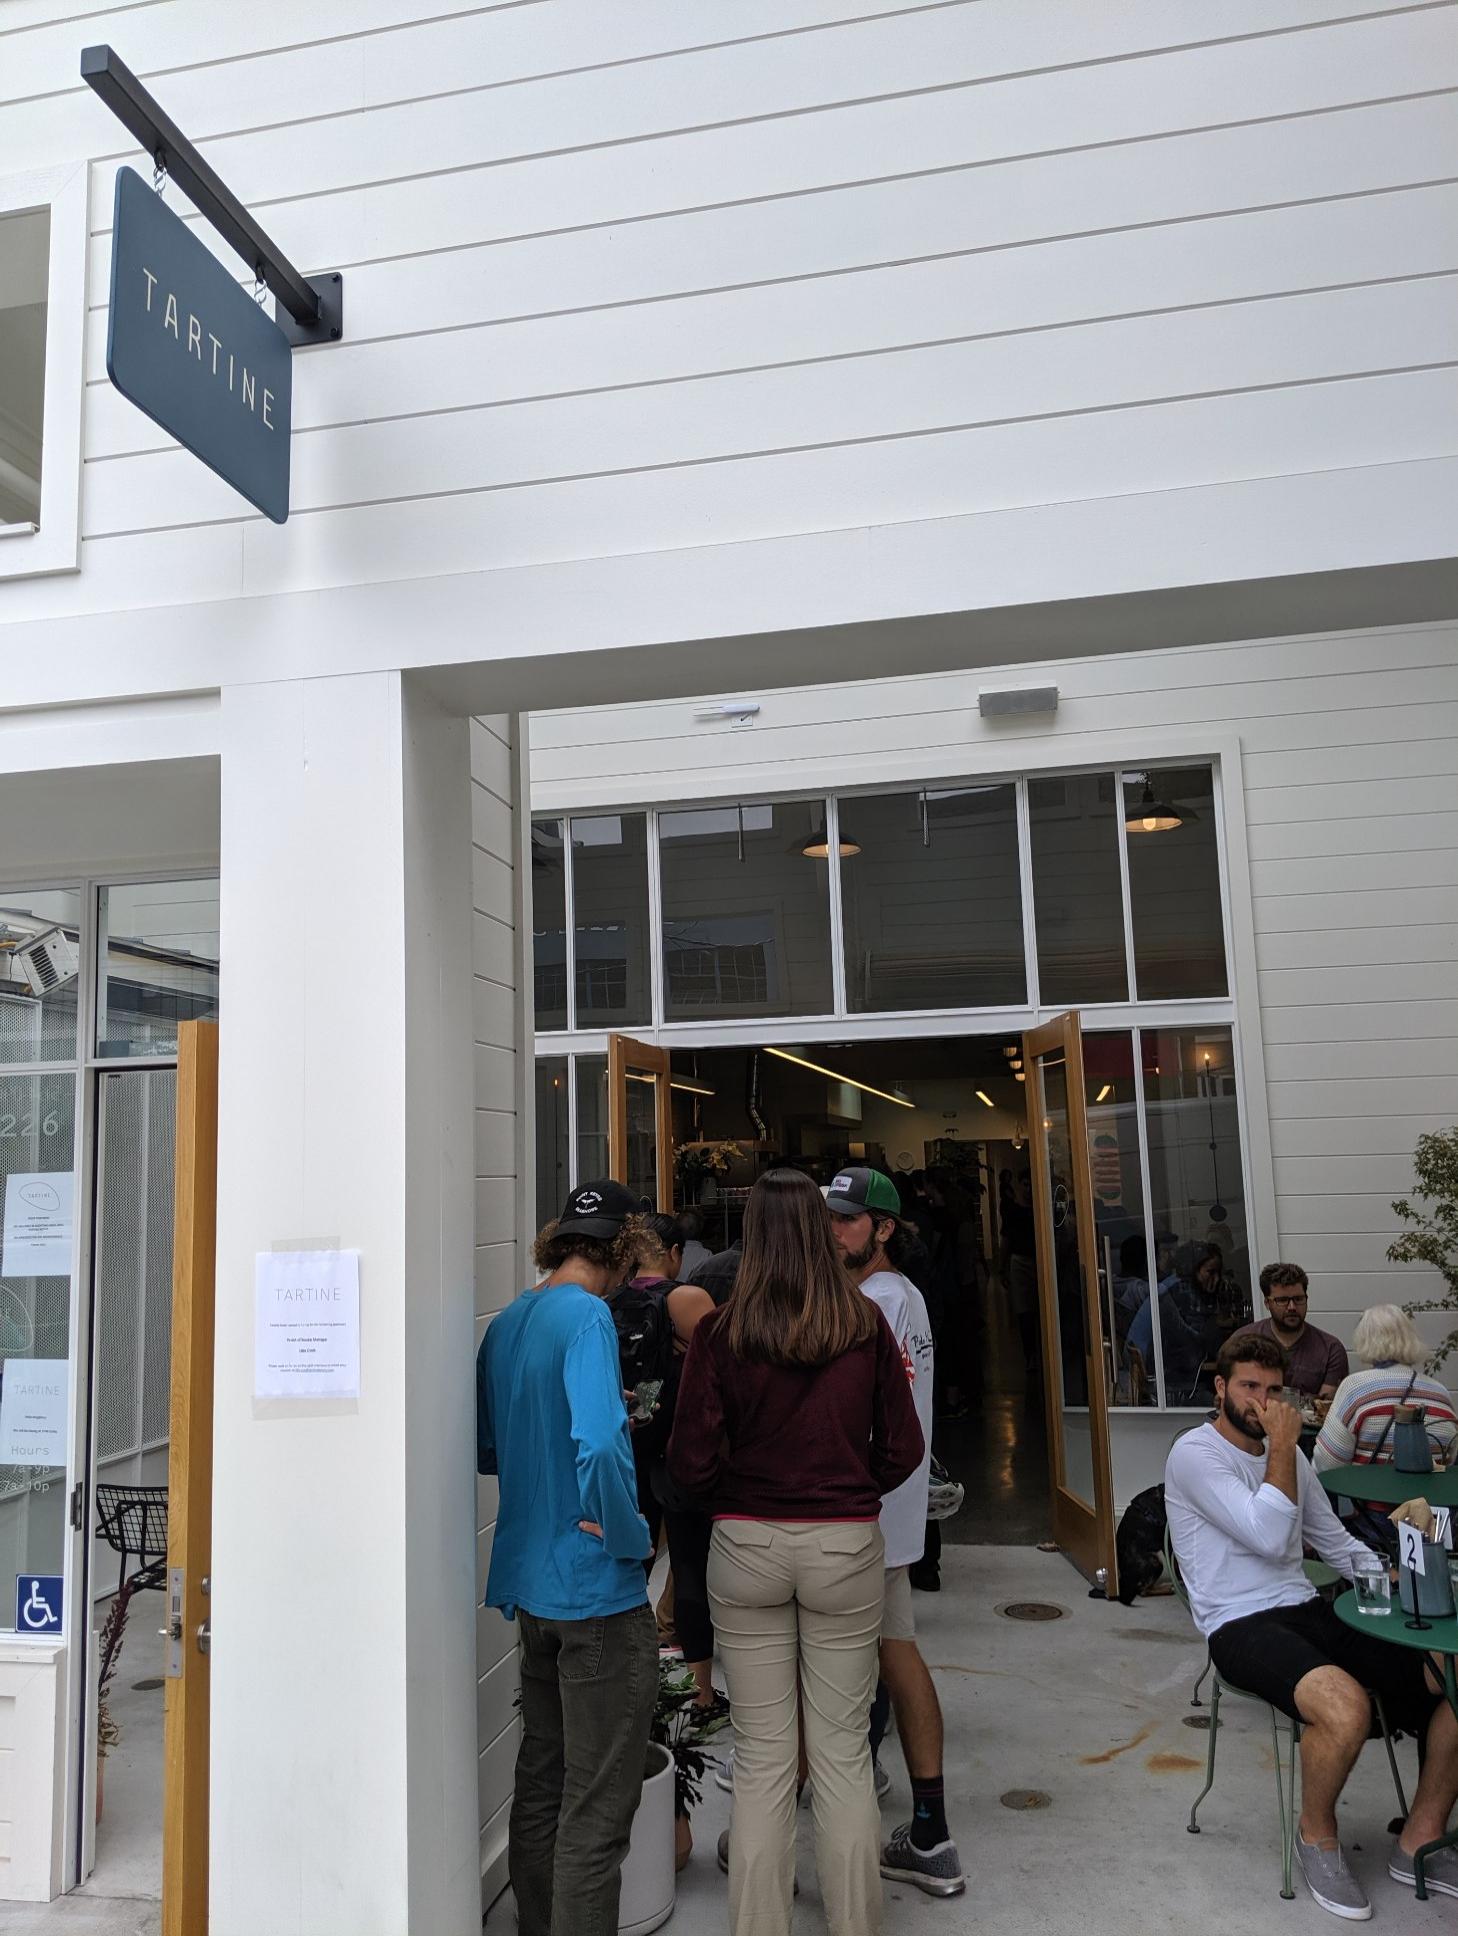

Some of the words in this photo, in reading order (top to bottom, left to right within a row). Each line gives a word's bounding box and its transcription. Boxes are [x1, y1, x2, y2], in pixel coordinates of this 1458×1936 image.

[142, 267, 275, 430] TARTINE
[274, 1287, 342, 1301] TARTINE
[14, 1384, 60, 1396] TARTINE
[11, 1445, 50, 1456] Hours
[1407, 1533, 1416, 1564] 2
